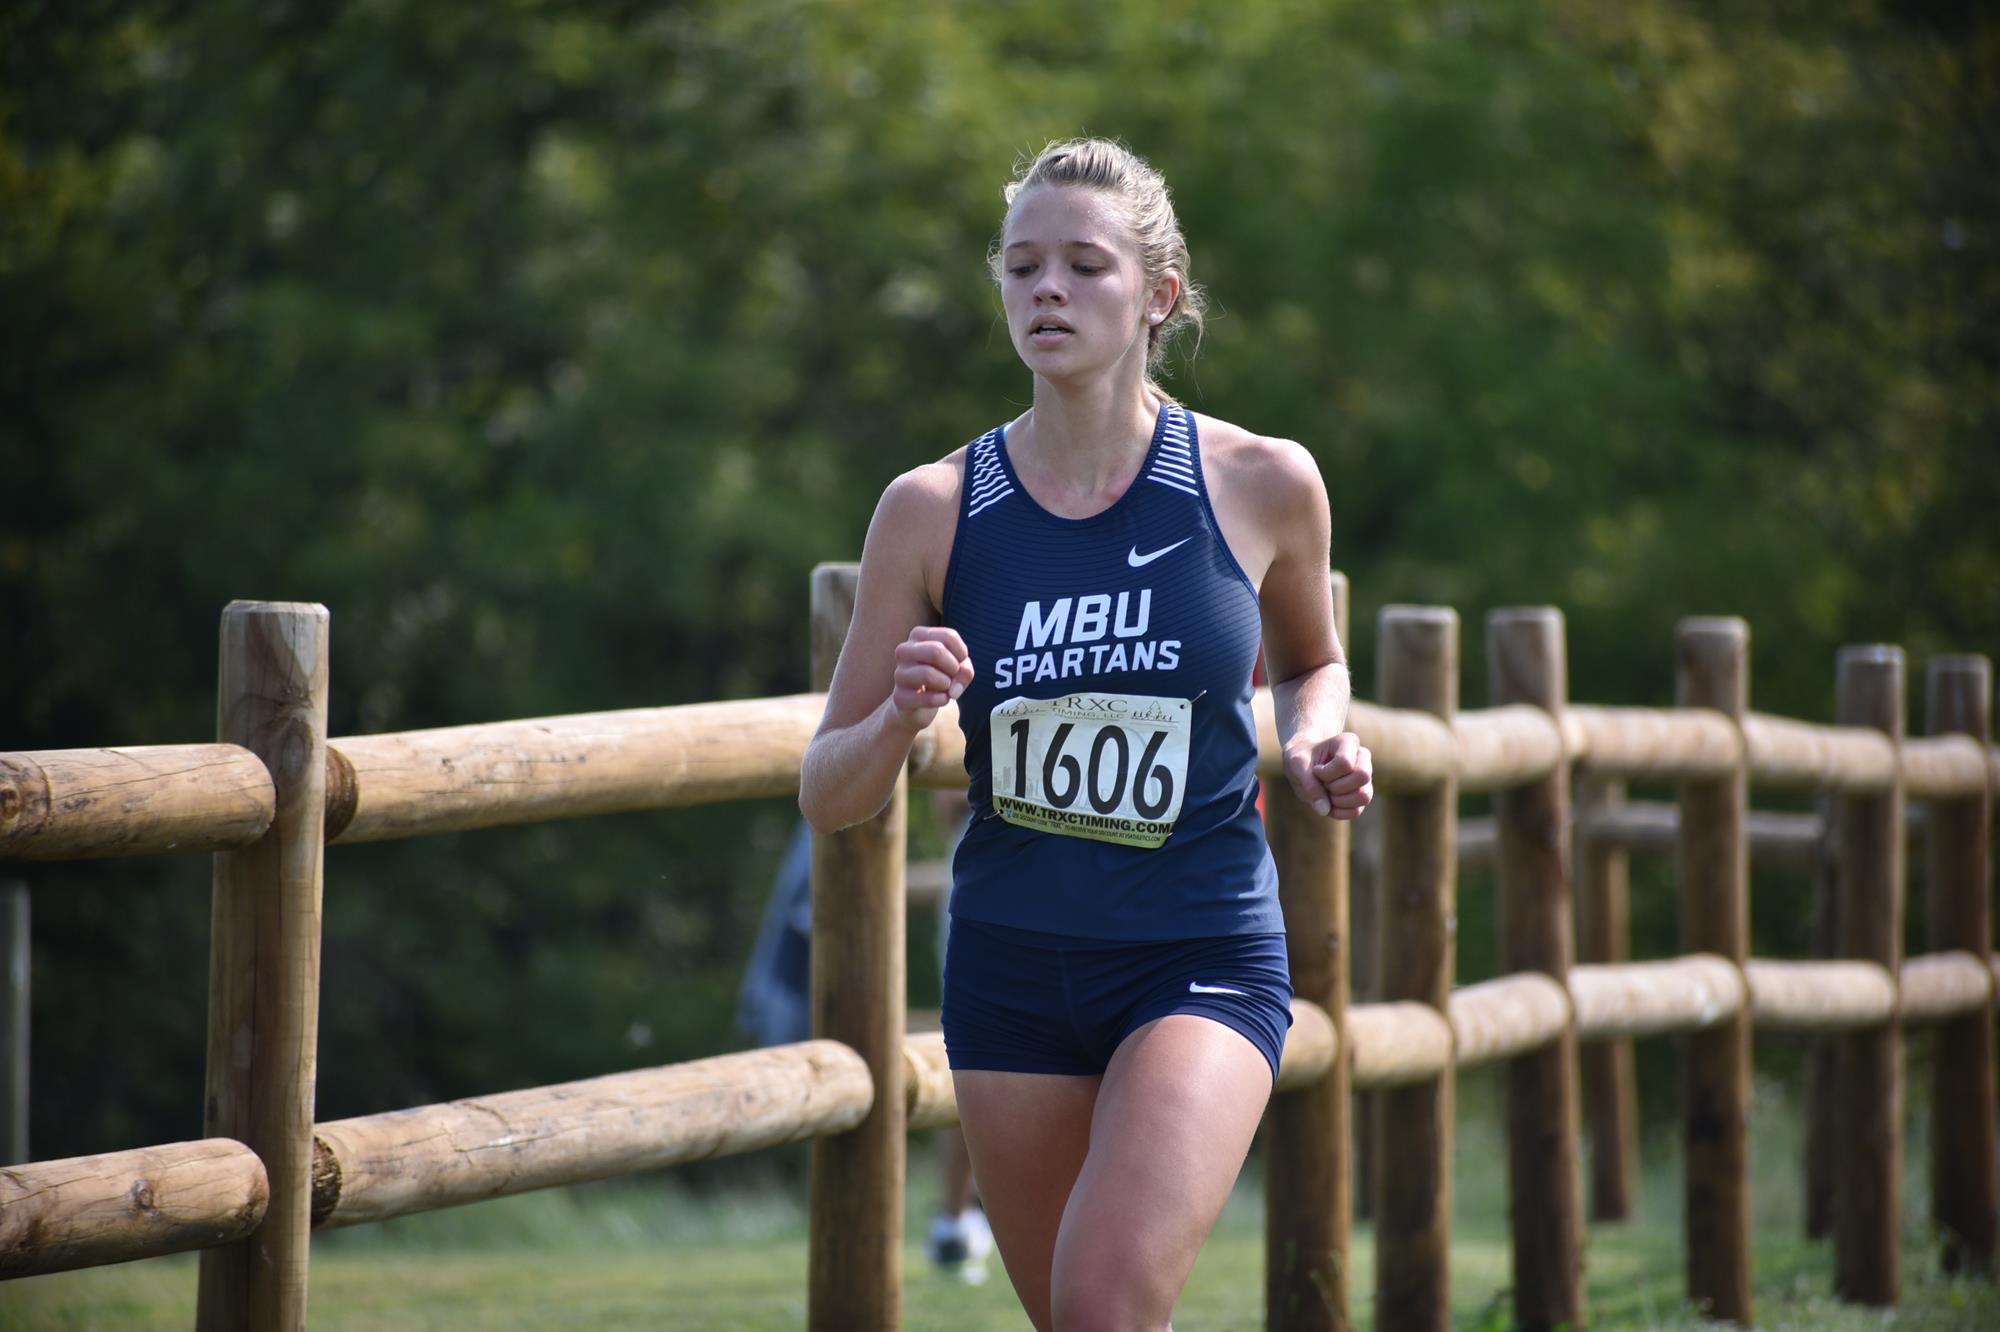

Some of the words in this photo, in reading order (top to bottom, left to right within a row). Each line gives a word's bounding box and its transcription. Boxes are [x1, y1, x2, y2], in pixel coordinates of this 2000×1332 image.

[1014, 588, 1152, 650] MBU
[994, 640, 1182, 689] SPARTANS
[1011, 718, 1174, 820] 1606
[999, 797, 1171, 834] WWW.TRXCTIMING.COM
